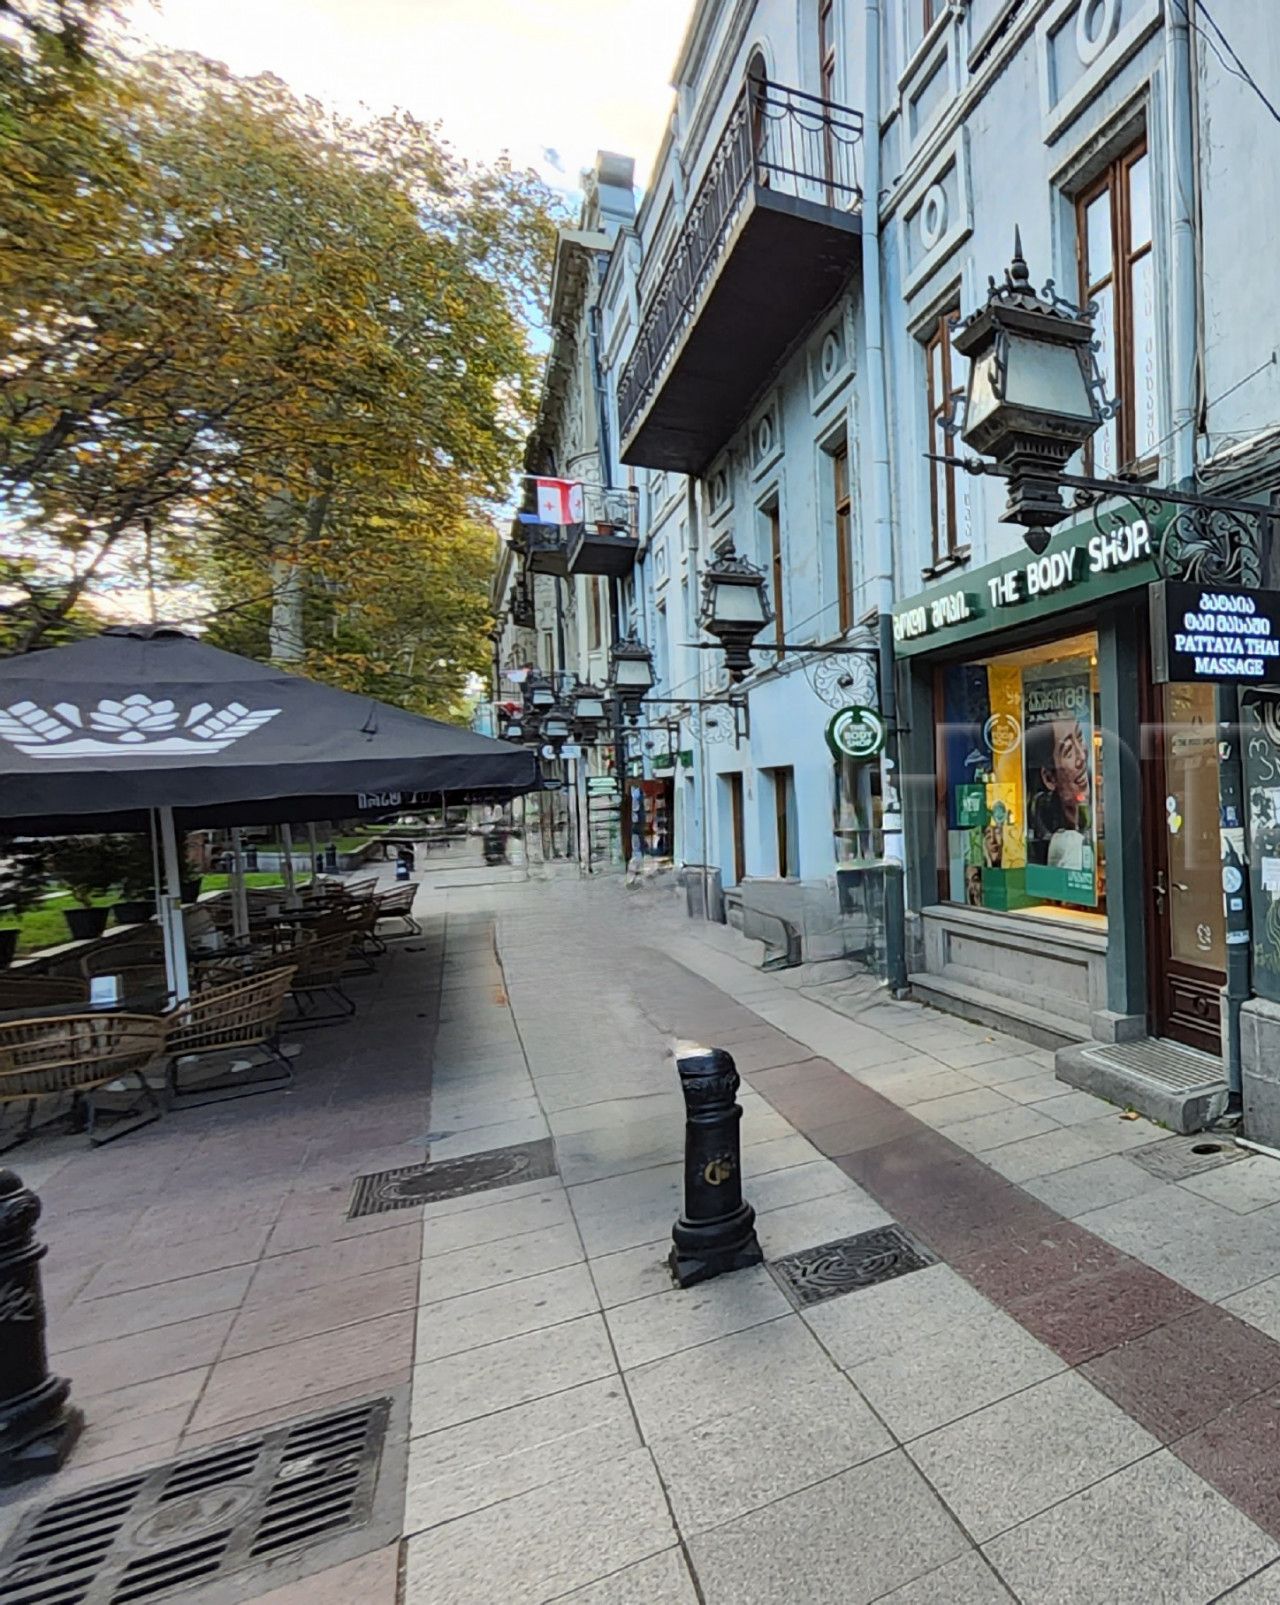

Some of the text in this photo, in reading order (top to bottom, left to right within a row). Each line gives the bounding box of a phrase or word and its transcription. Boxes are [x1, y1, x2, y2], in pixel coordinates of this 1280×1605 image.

[987, 570, 1020, 608] THE
[1026, 546, 1076, 595] BODY
[1174, 634, 1280, 656] PATTAYA THAI
[1194, 657, 1265, 675] MASSAGE
[844, 731, 873, 740] BODY
[847, 739, 872, 748] SHOP
